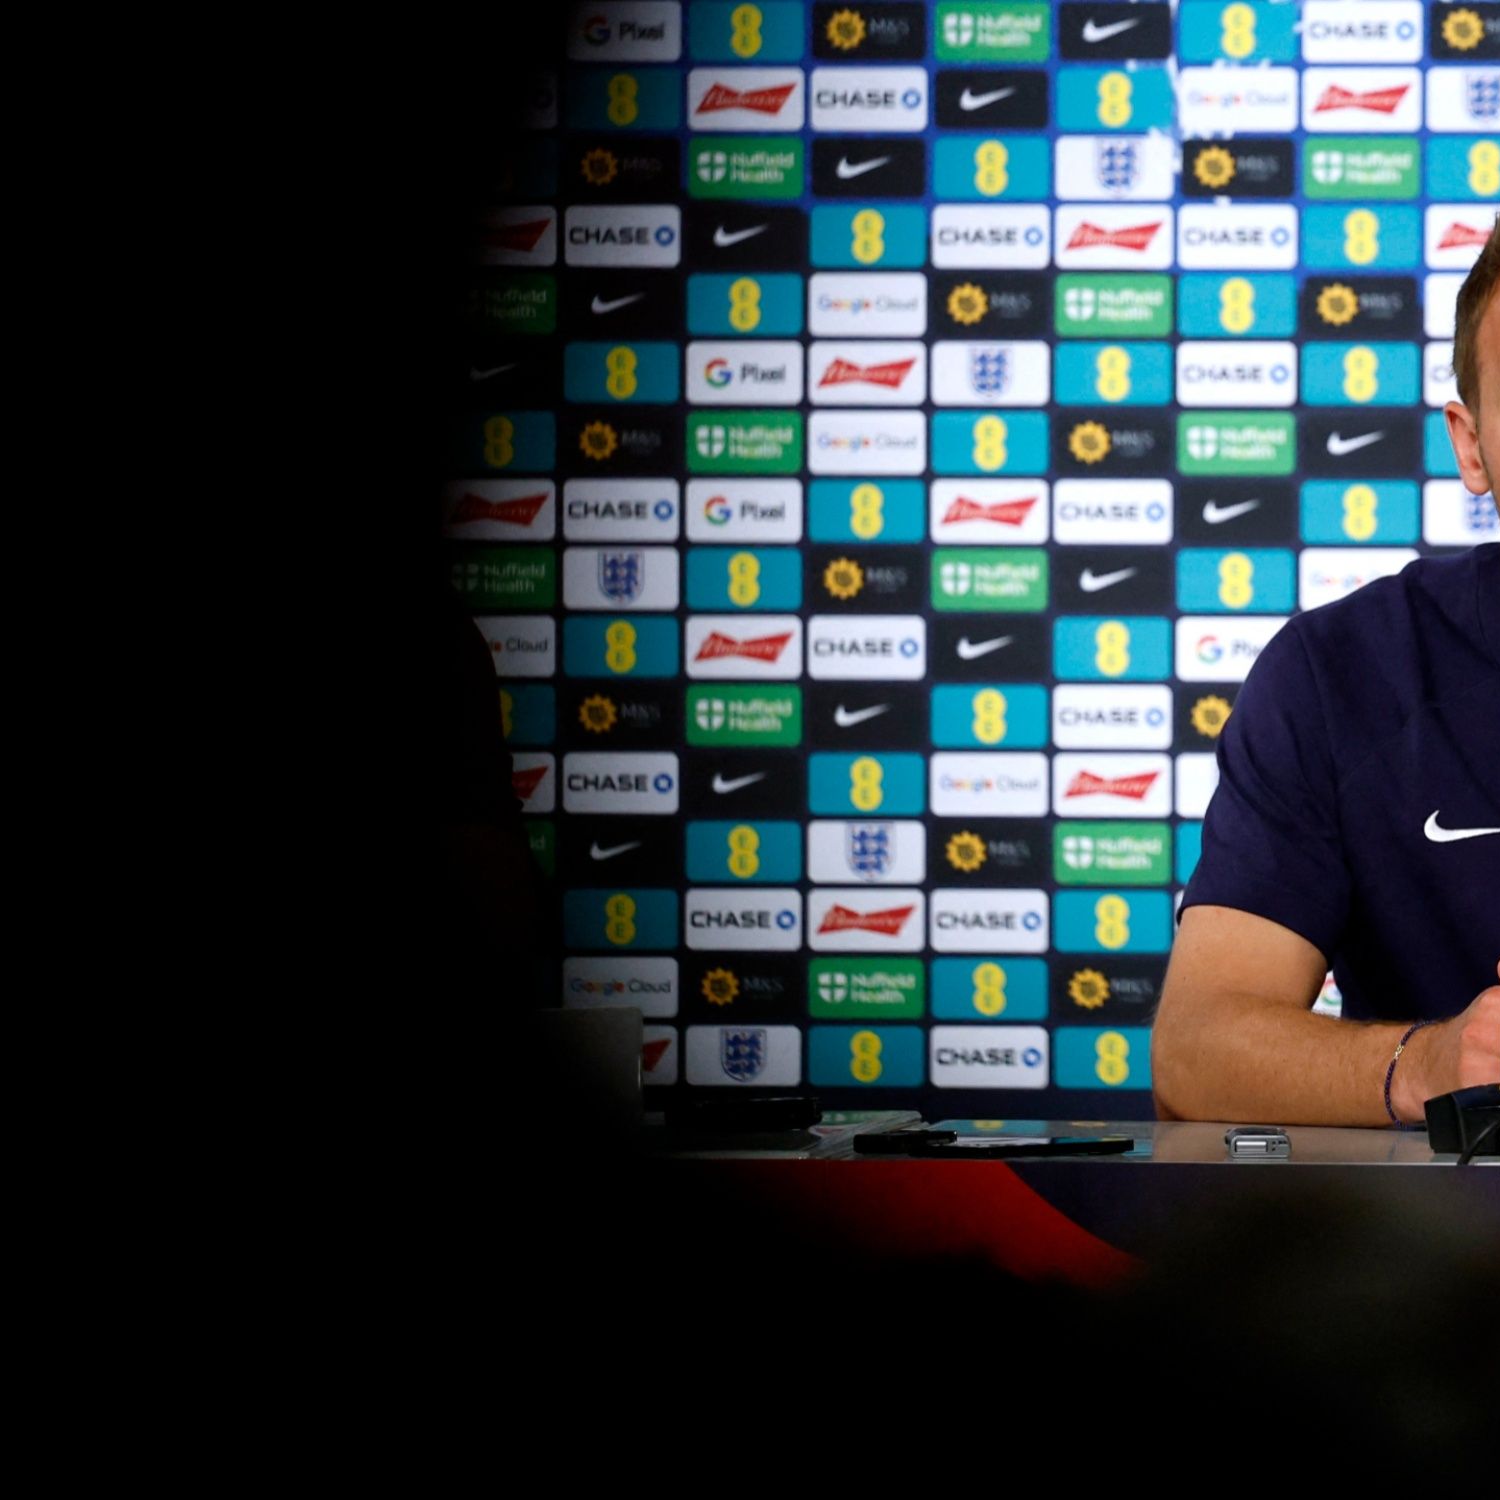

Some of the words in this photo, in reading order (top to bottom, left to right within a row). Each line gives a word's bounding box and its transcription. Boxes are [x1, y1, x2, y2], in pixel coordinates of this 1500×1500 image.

[976, 13, 1040, 30] Nuffield
[618, 23, 663, 40] Pixel
[977, 30, 1029, 46] Health
[1308, 22, 1388, 39] CHASE
[816, 91, 896, 108] CHASE
[730, 151, 794, 168] Nuffield
[731, 168, 783, 184] Health
[569, 228, 649, 245] CHASE
[938, 228, 1018, 245] CHASE
[1184, 228, 1264, 245] CHASE
[818, 299, 873, 316] Google
[877, 298, 919, 312] Cloud
[741, 365, 786, 382] Pixel
[1184, 364, 1264, 381] CHASE
[729, 425, 793, 442] Nuffield
[730, 442, 782, 458] Health
[817, 436, 872, 453] Google
[876, 435, 918, 449] Cloud
[569, 501, 649, 518] CHASE
[741, 502, 786, 519] Pixel
[1061, 501, 1141, 518] CHASE
[976, 561, 1040, 578] Nuffield
[977, 578, 1029, 594] Health
[506, 639, 547, 653] Cloud
[815, 638, 895, 655] CHASE
[730, 698, 794, 715] Nuffield
[731, 715, 783, 731] Health
[1061, 707, 1141, 724] CHASE
[569, 774, 649, 791] CHASE
[941, 776, 996, 793] Google
[1000, 775, 1042, 789] Cloud
[692, 911, 772, 928] CHASE
[938, 911, 1018, 928] CHASE
[570, 980, 625, 997] Google
[628, 979, 670, 993] Cloud
[853, 971, 917, 988] Nuffield
[854, 988, 906, 1004] Health
[938, 1049, 1018, 1066] CHASE
